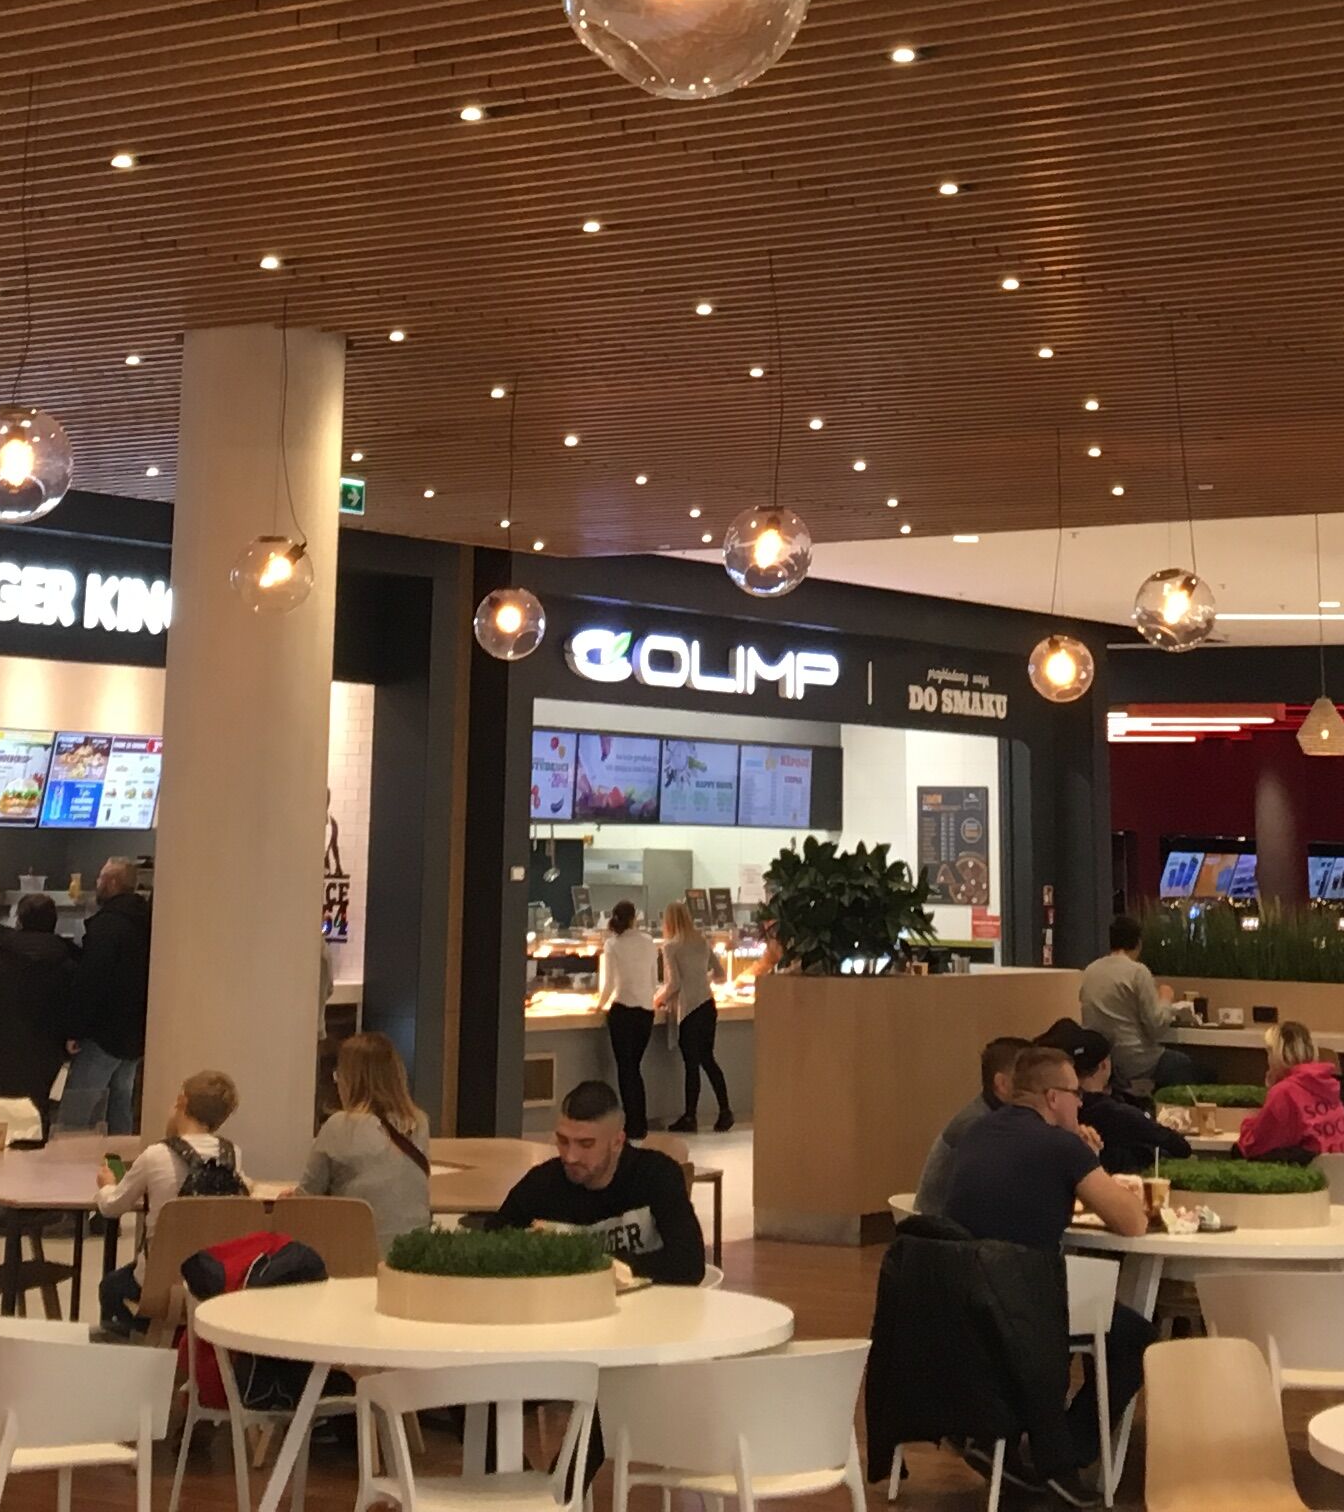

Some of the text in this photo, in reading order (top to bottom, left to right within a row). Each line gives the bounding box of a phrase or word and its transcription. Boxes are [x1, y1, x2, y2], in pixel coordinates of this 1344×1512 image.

[632, 633, 840, 700] OLIMP
[908, 684, 1008, 720] DO SMAKU
